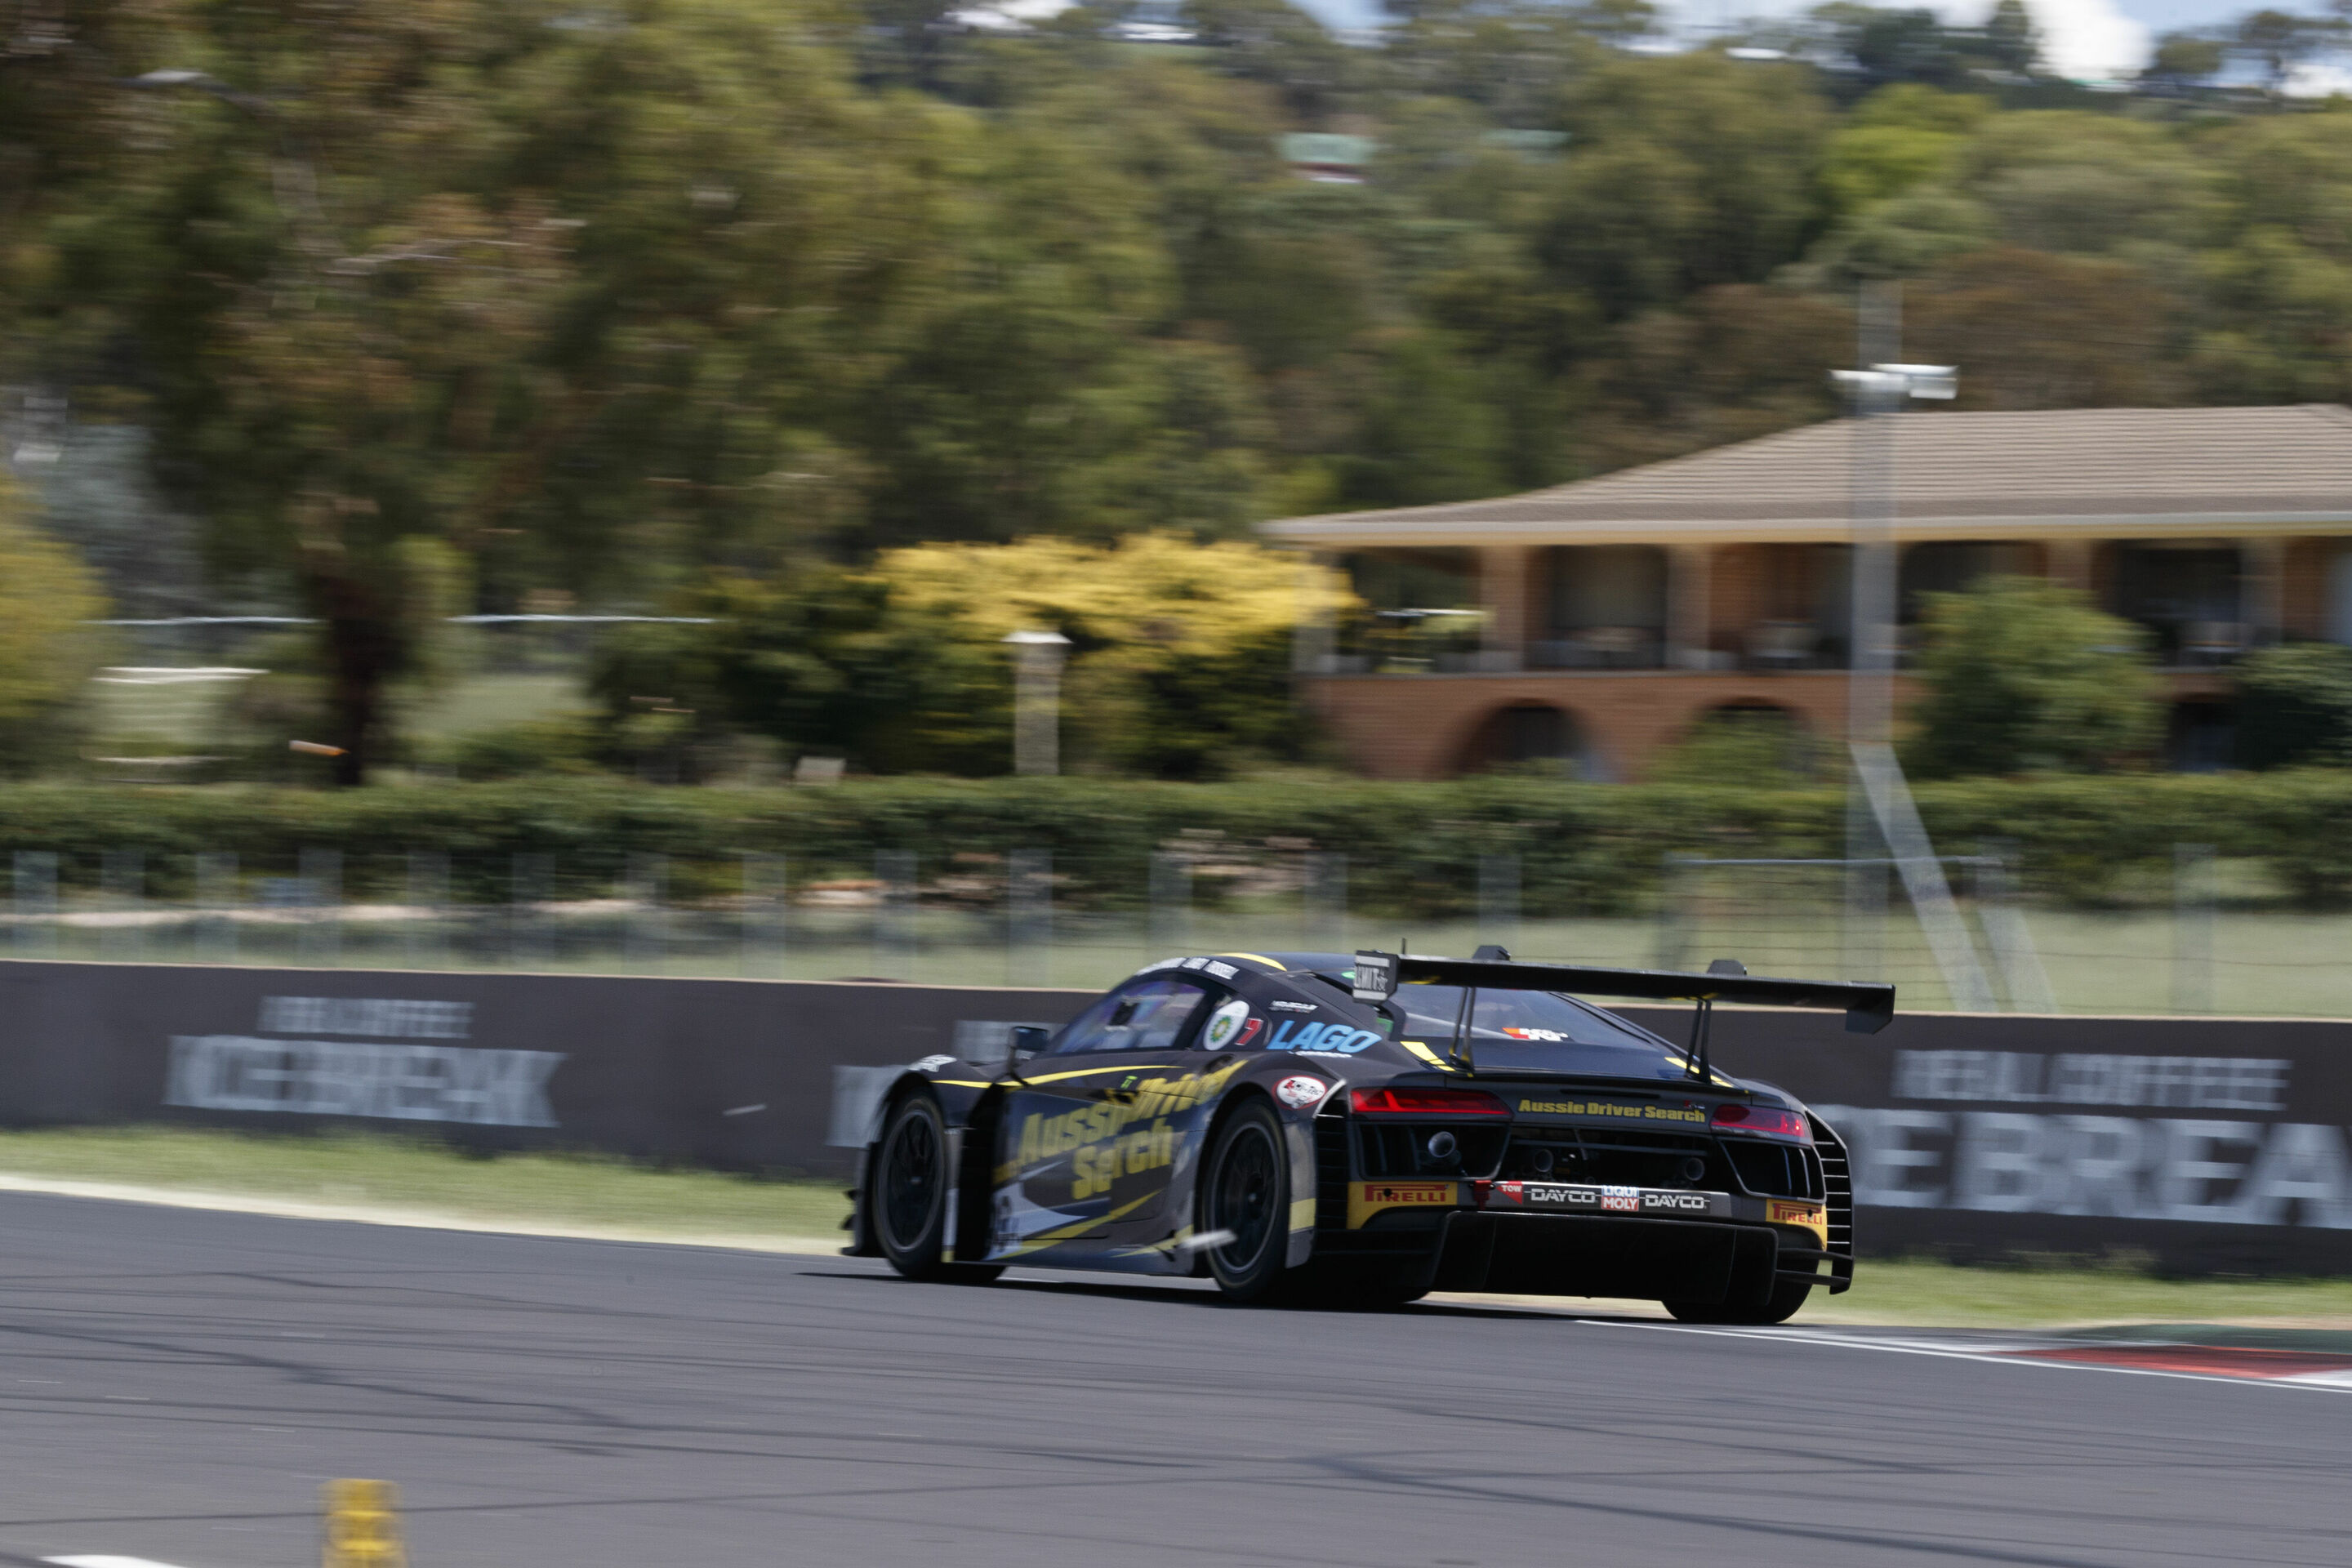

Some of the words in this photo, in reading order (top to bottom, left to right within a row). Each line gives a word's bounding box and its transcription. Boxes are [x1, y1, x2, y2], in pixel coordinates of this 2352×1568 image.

[1235, 1018, 1263, 1045] 7
[1267, 1020, 1382, 1053] LAGO
[1518, 1099, 1585, 1114] Aussie
[1587, 1102, 1642, 1118] Driver
[1645, 1106, 1705, 1122] Search
[1364, 1184, 1447, 1202] PIRELLI
[1502, 1184, 1521, 1192] TOW
[1530, 1188, 1595, 1203] DAYCO
[1603, 1186, 1639, 1197] LIQUI
[1603, 1198, 1638, 1209] MOLY
[1645, 1194, 1704, 1209] DAYCO
[1773, 1203, 1822, 1225] PIRELLI
